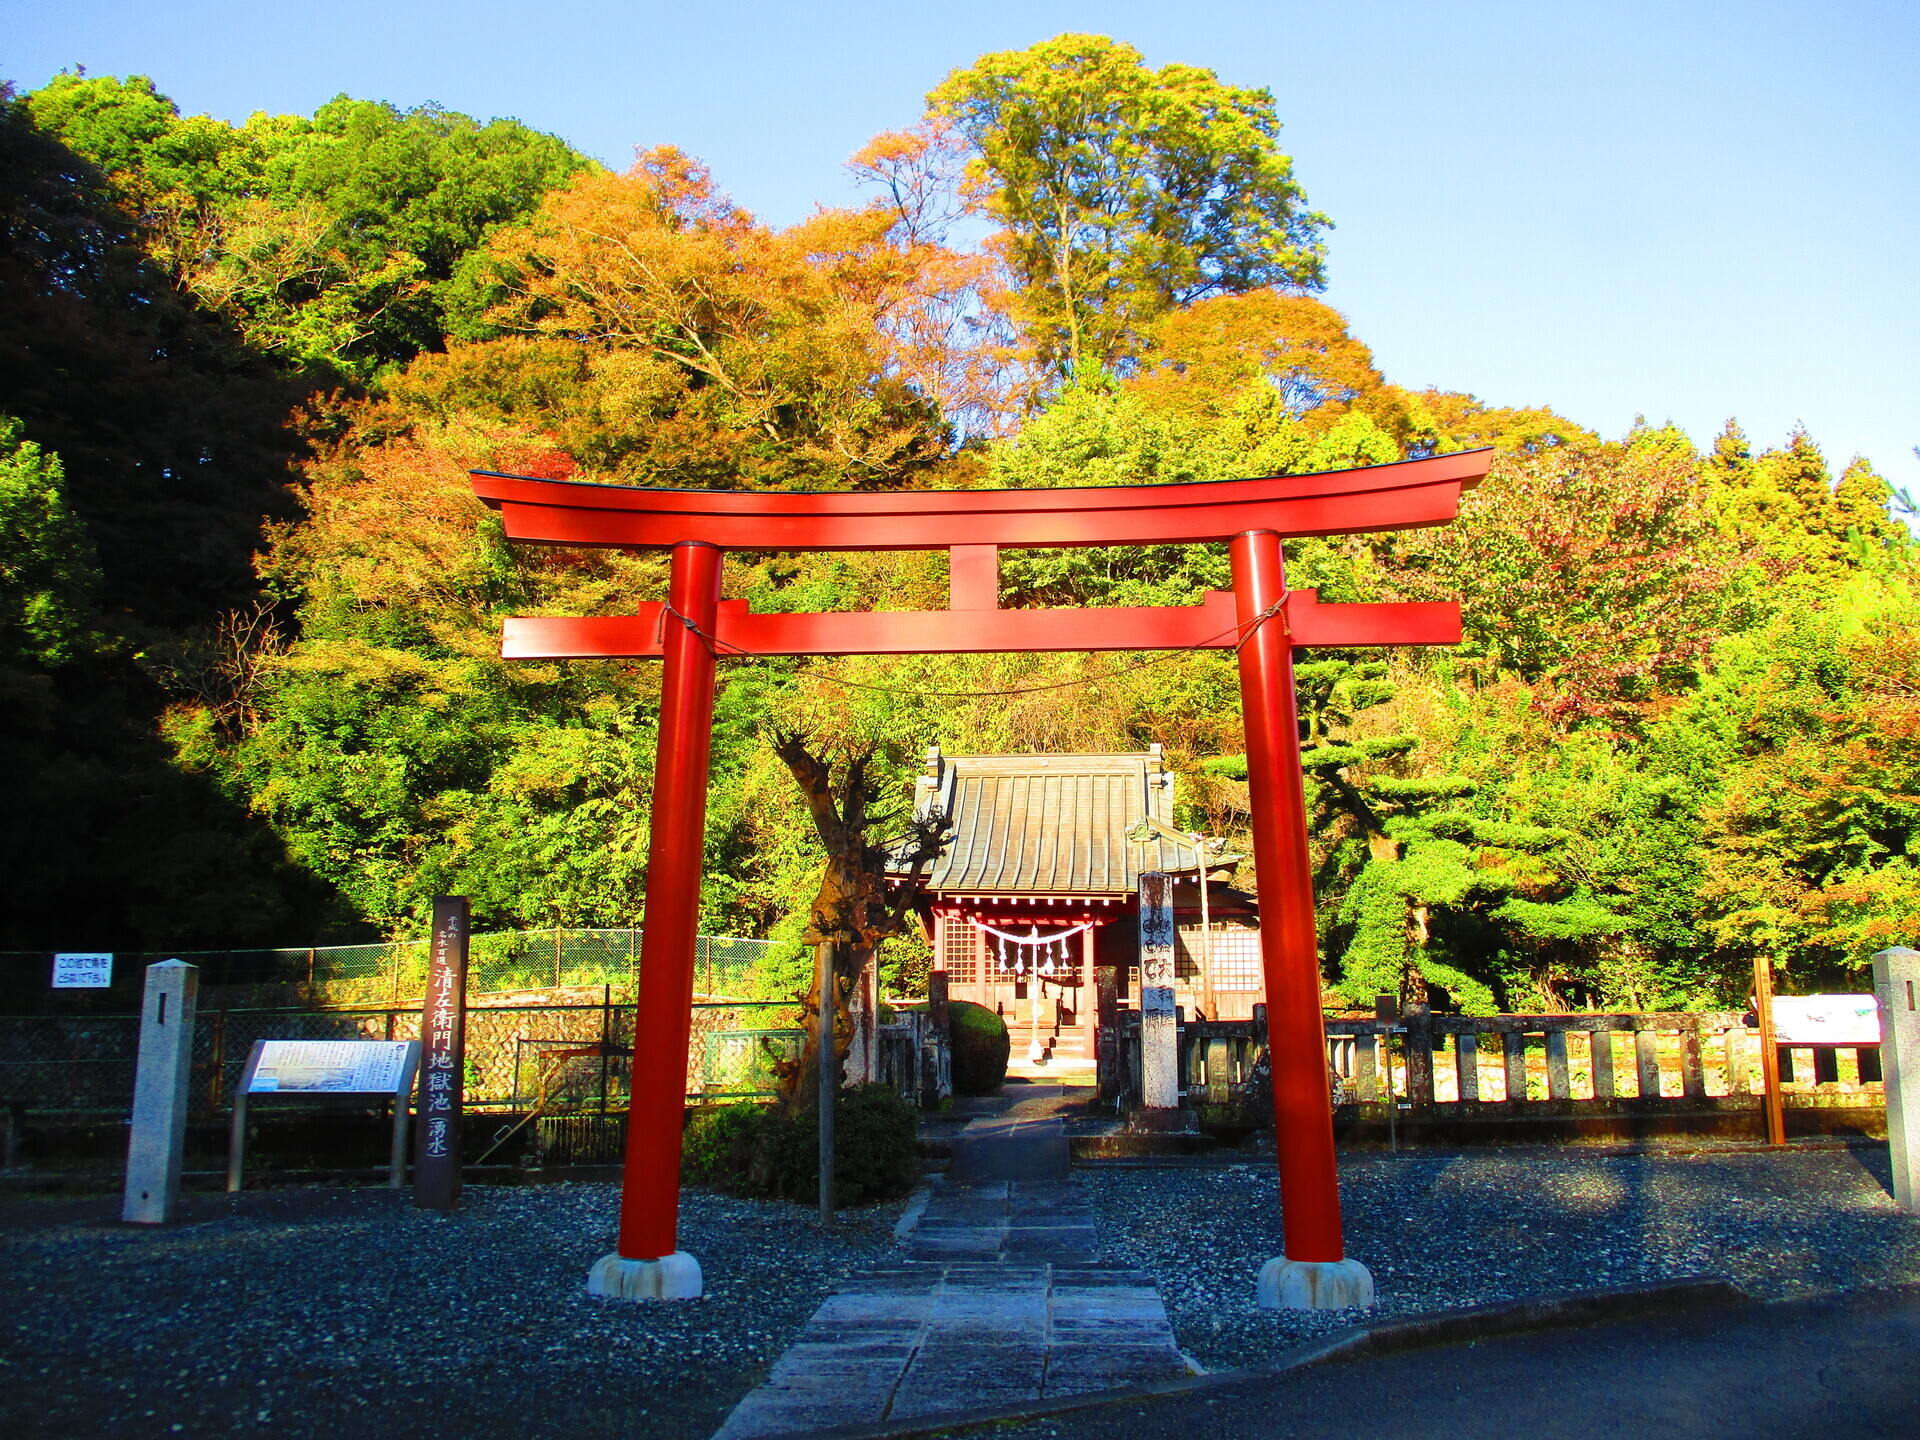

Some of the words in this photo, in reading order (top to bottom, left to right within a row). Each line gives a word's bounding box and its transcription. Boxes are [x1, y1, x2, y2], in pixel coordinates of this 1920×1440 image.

[447, 915, 459, 939] 平成の
[435, 930, 449, 966] 名水百選
